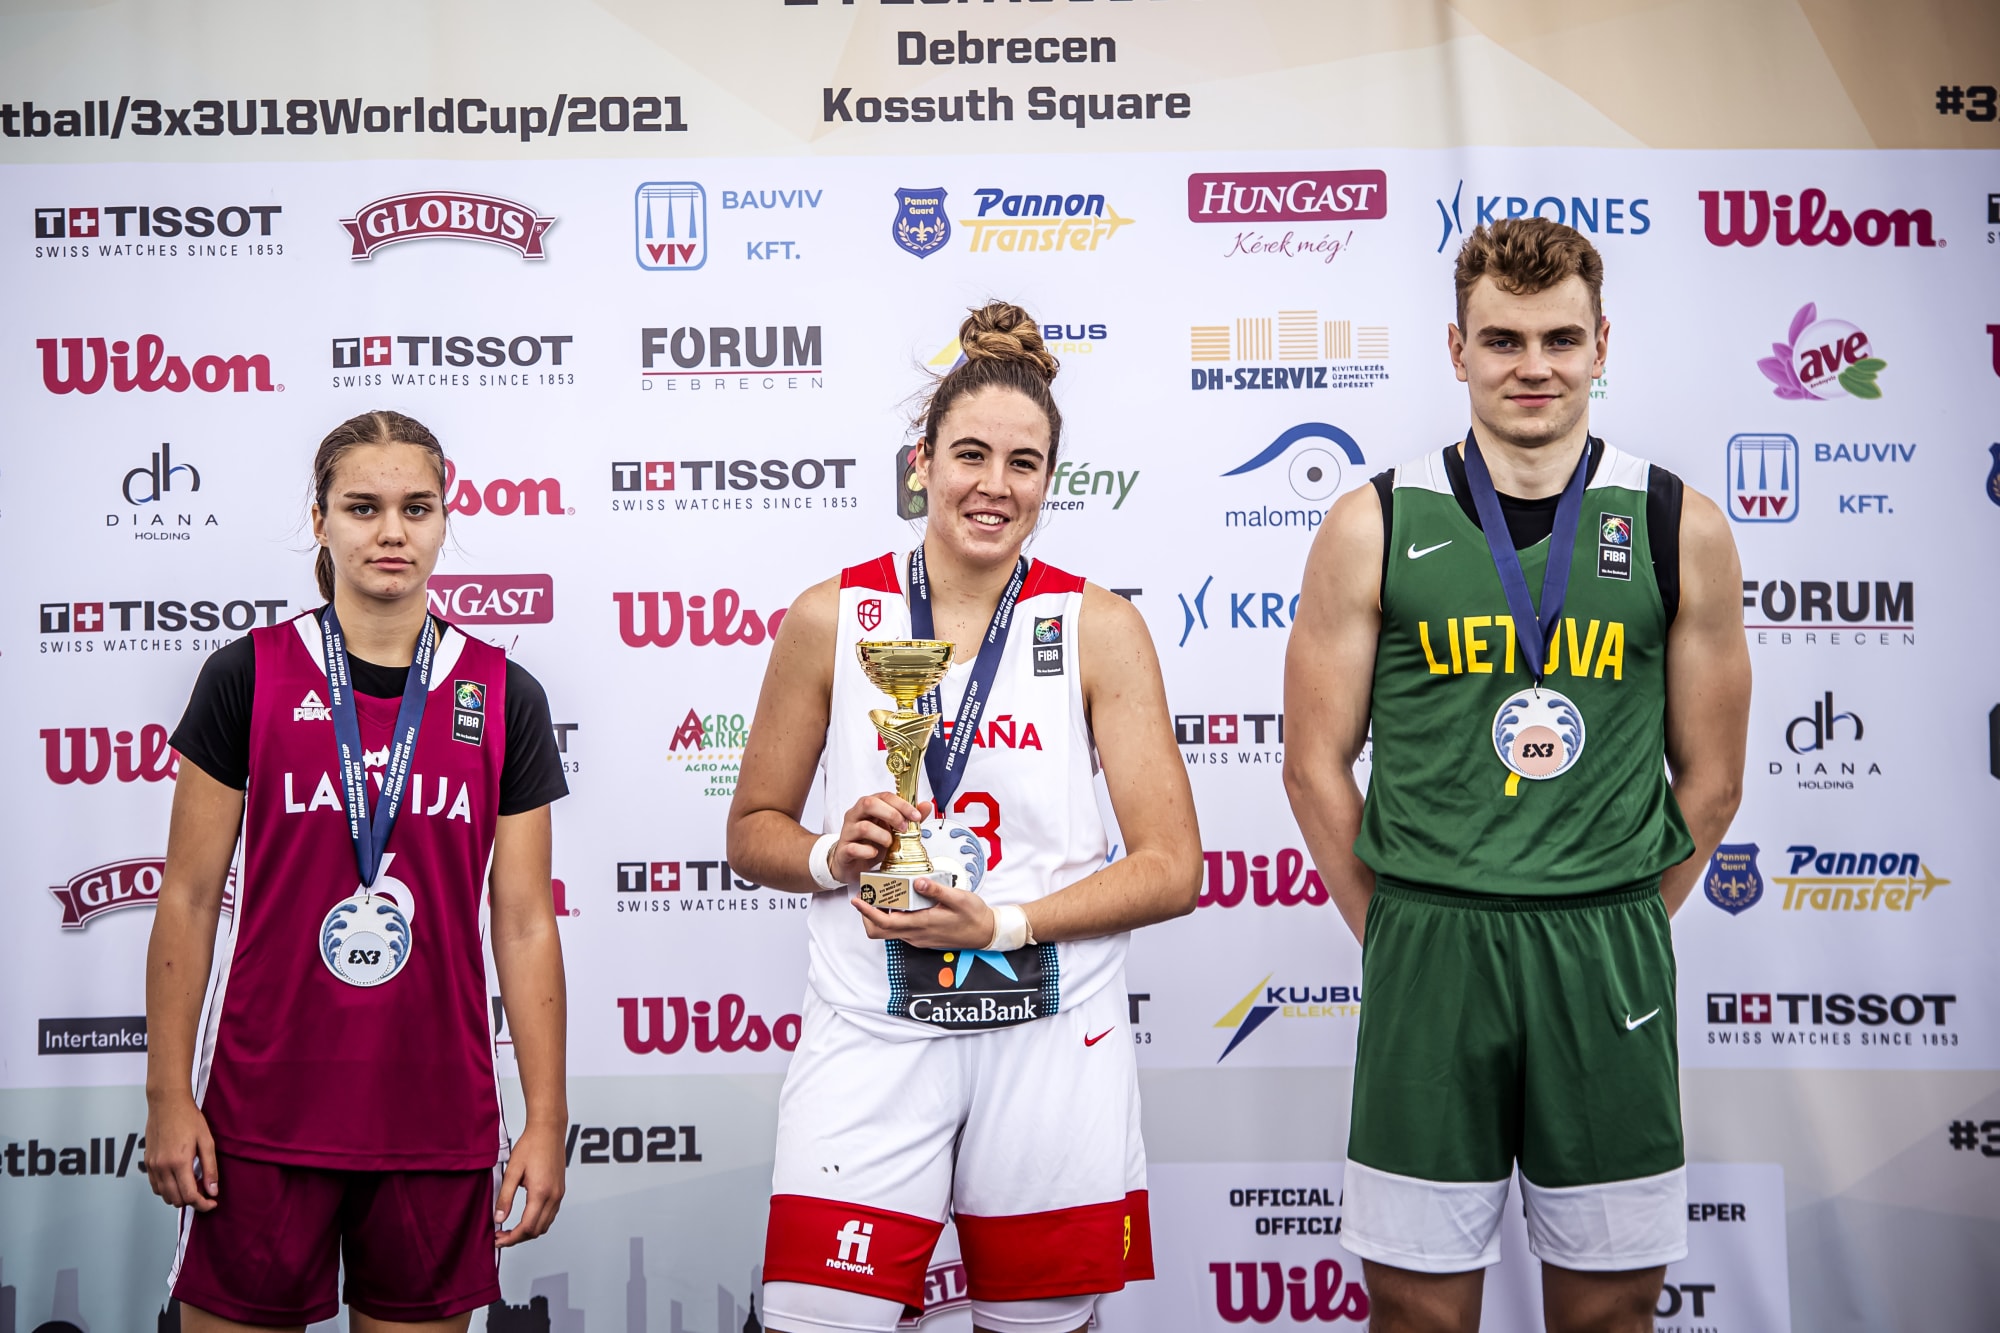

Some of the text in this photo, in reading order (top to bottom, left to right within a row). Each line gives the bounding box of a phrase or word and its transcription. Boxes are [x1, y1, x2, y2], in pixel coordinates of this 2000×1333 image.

[897, 30, 1116, 65] Debrecen
[823, 86, 1191, 128] Kossuth Square
[1936, 85, 2000, 122] #3
[722, 189, 823, 209] BAUVIV
[904, 197, 939, 206] Pannon
[973, 188, 1105, 217] Pannon
[365, 200, 525, 239] GLOBUS
[909, 207, 934, 215] Guard
[1477, 196, 1651, 235] KRONES
[1698, 188, 1937, 247] Wilson
[104, 206, 282, 237] TISSOT
[957, 218, 1112, 252] Transfer
[35, 244, 284, 258] SWISS WATCHES SINCE 1853
[646, 243, 697, 265] VIV
[747, 241, 801, 260] KFT.
[1223, 230, 1353, 264] Kérek még!
[1043, 324, 1107, 340] BUS
[397, 336, 573, 367] TISSOT
[642, 326, 822, 368] FORUM
[36, 334, 275, 394] Wilson
[1801, 332, 1868, 383] ave
[333, 373, 574, 388] SWISS WATCHES SINCE 1853
[642, 377, 823, 391] DEBRECEN
[1191, 367, 1328, 390] DH-SZERVIZ
[1815, 443, 1917, 463] BAUVIV
[680, 459, 856, 490] TISSOT
[1053, 461, 1140, 510] fény
[612, 497, 858, 511] SWISS WATCHES SINCE 1853
[1042, 501, 1084, 510] recen
[1738, 496, 1788, 517] VIV
[1839, 495, 1894, 513] KFT.
[106, 514, 218, 526] DIANA
[135, 532, 190, 540] HOLDING
[1603, 549, 1626, 563] FIBA
[427, 584, 544, 617] NGAST
[988, 625, 998, 644] FIBA
[1005, 573, 1020, 598] WORLD
[1000, 580, 1023, 629] HUNGARY 2021
[1743, 580, 1914, 622] FORUM
[109, 600, 288, 631] TISSOT
[613, 588, 790, 648] Wils
[40, 639, 231, 653] SWISS WATCHES SIN
[326, 635, 335, 658] WORLD
[1758, 632, 1915, 645] EBRECEN
[334, 633, 347, 686] HUNGARY 2021
[416, 646, 424, 665] 2021
[422, 646, 431, 670] WORLD
[1037, 649, 1059, 661] FIBA
[329, 659, 337, 672] U18
[420, 669, 428, 685] CUP
[333, 688, 341, 705] FIBA
[969, 680, 979, 697] CUP
[293, 707, 332, 721] PEAK
[960, 695, 974, 723] WORLD
[458, 714, 479, 728] FIBA
[956, 722, 965, 736] U18
[958, 700, 982, 755] HUNGARY 2021
[405, 727, 415, 745] FIBA
[669, 725, 749, 752] MARKE
[342, 744, 350, 759] CUP
[1186, 751, 1283, 764] WISS WATC
[384, 742, 403, 797] HUNGARY 2021
[398, 759, 408, 775] U18
[685, 763, 718, 772] AGRO
[945, 753, 956, 771] FIBA
[1769, 762, 1881, 775] DIANA
[344, 760, 354, 786] WORLD
[710, 775, 738, 784] KERE
[348, 787, 356, 802] U18
[353, 761, 366, 818] HUNGARY 2021
[392, 774, 404, 802] WORLD
[1798, 781, 1854, 790] HOLDING
[284, 770, 471, 823] LAIJA
[388, 801, 398, 819] CUP
[351, 820, 359, 839] FIBA
[1716, 852, 1751, 862] Pannon
[1786, 846, 1920, 876] Pannon
[1196, 848, 1329, 908] Wils
[1771, 877, 1927, 911] Transfer
[617, 898, 809, 912] SWISS WATCHES SINC
[1267, 986, 1361, 1003] KUJB
[908, 997, 1037, 1023] CaixaBank
[1283, 1006, 1360, 1017] ELEKT
[1777, 994, 1957, 1025] TISSOT
[617, 994, 802, 1055] Wilso
[1135, 1032, 1151, 1044] 53
[1707, 1032, 1959, 1046] SWISS WATCHES SINCE 1853
[565, 1124, 702, 1167] /2021
[1230, 1189, 1334, 1207] OFFICIAL
[1688, 1203, 1746, 1222] EPER
[1255, 1217, 1342, 1236] OFFICIA
[836, 1219, 874, 1264] fi
[825, 1258, 875, 1276] network
[1209, 1259, 1370, 1324] Wils
